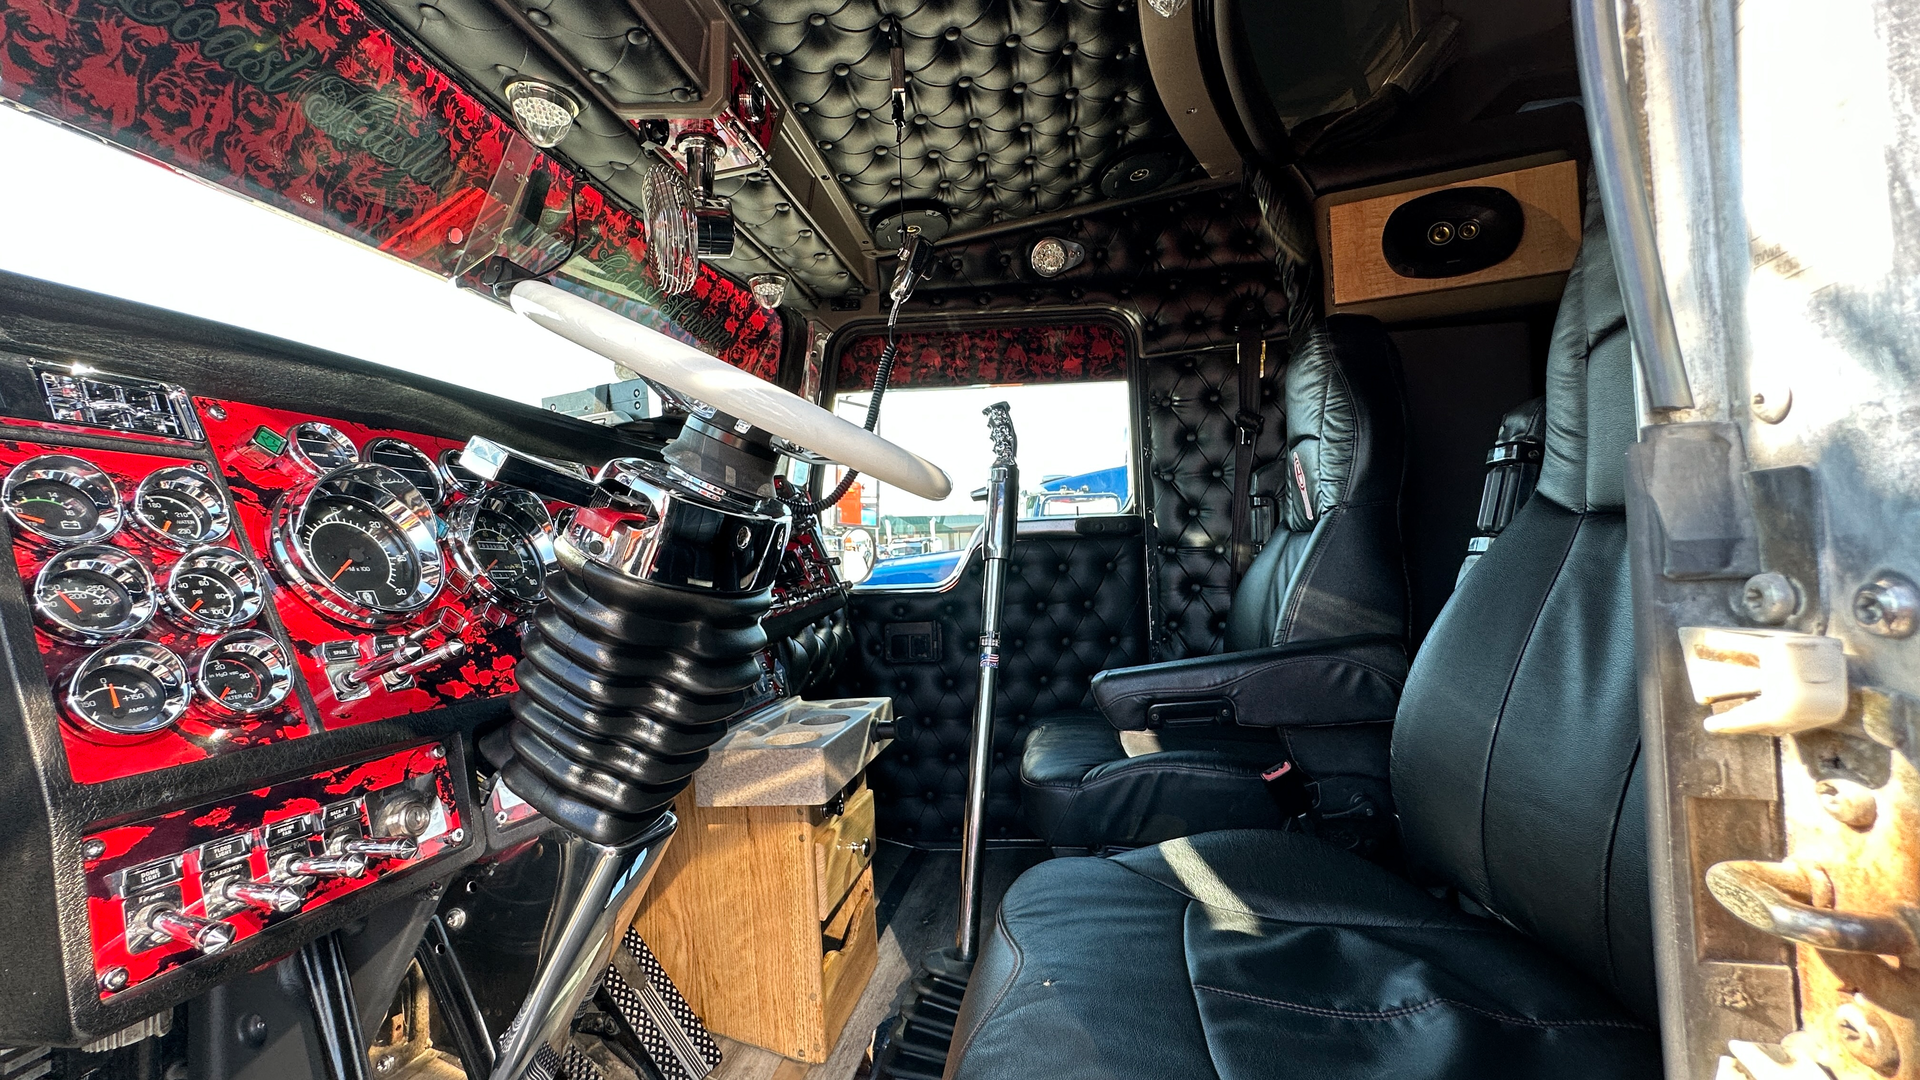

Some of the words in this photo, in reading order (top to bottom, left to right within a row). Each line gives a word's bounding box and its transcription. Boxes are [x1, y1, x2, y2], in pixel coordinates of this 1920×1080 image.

[47, 491, 59, 499] 14
[368, 521, 381, 529] 20
[86, 584, 106, 593] 250
[394, 588, 407, 596] 30
[92, 598, 112, 606] 300
[213, 663, 226, 671] 20
[239, 672, 251, 680] 30
[99, 677, 107, 685] 0
[128, 705, 149, 714] AMPS
[213, 844, 232, 854] FLOOD
[215, 848, 232, 859] LIGHT
[140, 867, 160, 878] DOME
[140, 873, 161, 884] LIGHT
